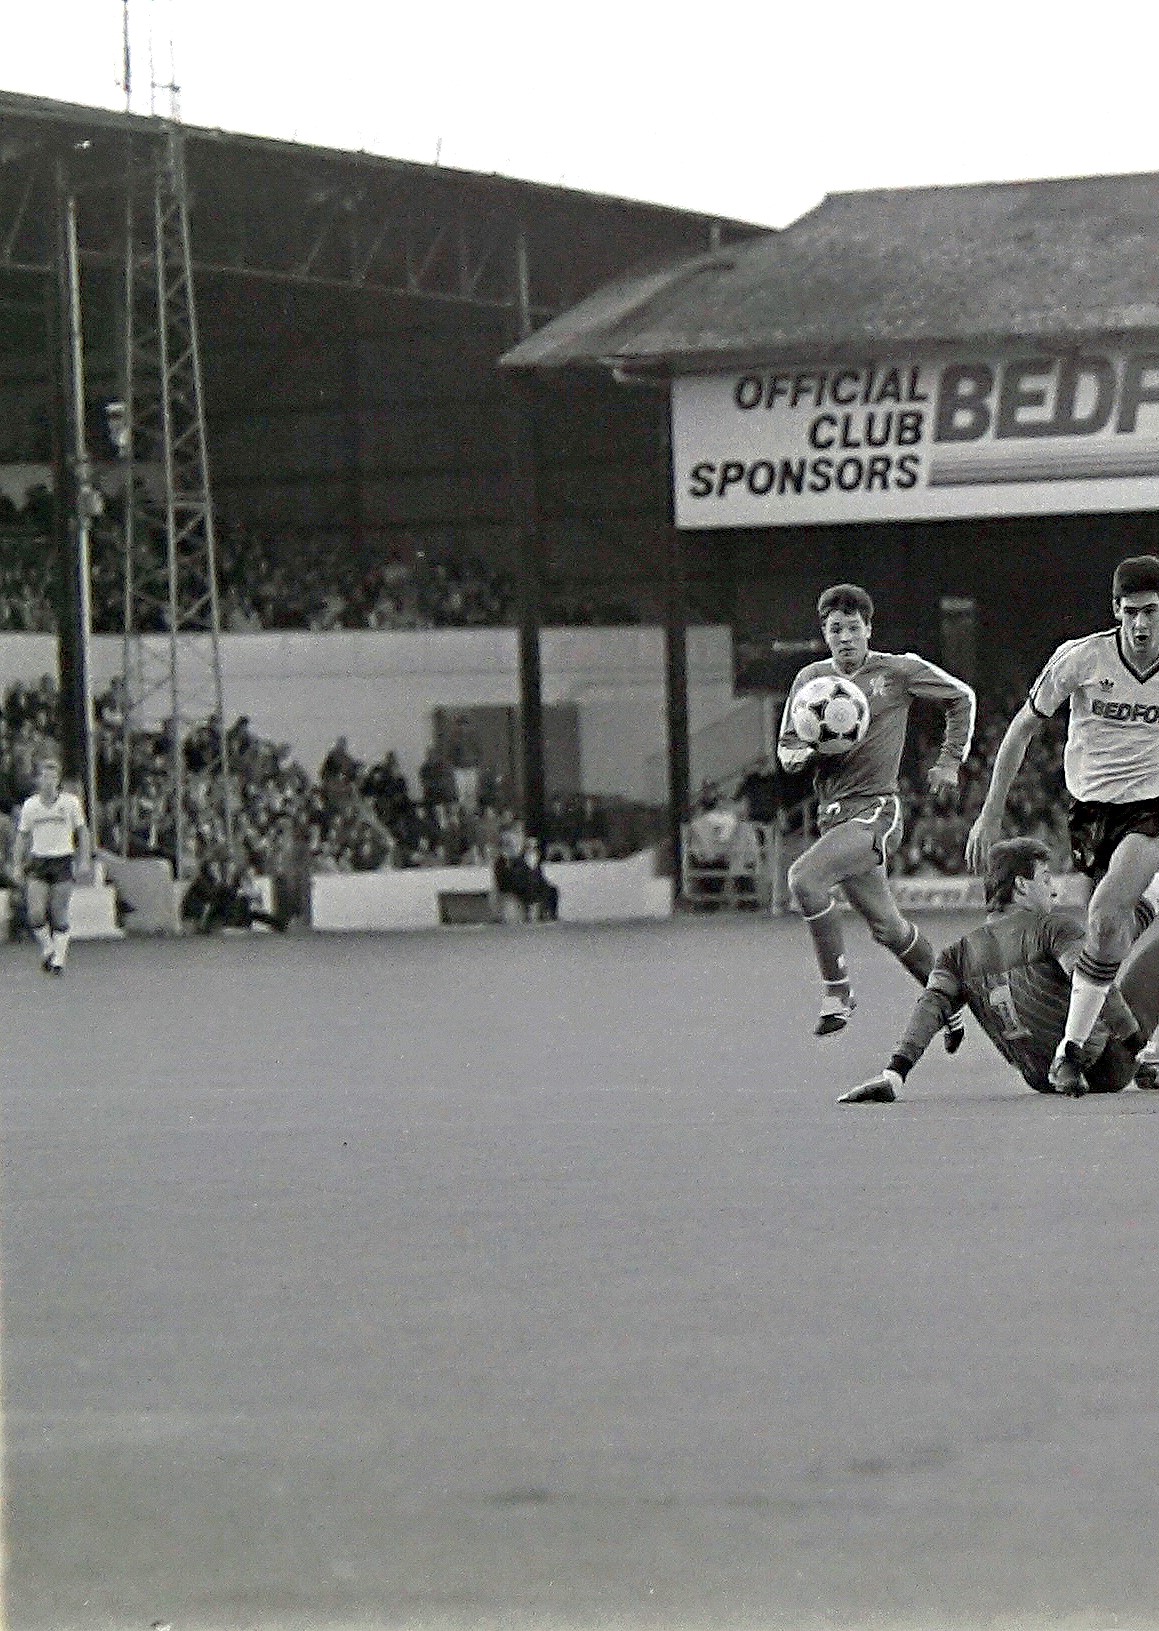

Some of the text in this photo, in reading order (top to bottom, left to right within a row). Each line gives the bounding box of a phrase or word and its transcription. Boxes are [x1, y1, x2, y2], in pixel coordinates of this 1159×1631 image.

[734, 365, 927, 409] OFFICIAL
[808, 410, 923, 449] CLUB
[689, 453, 920, 498] SPONSORS
